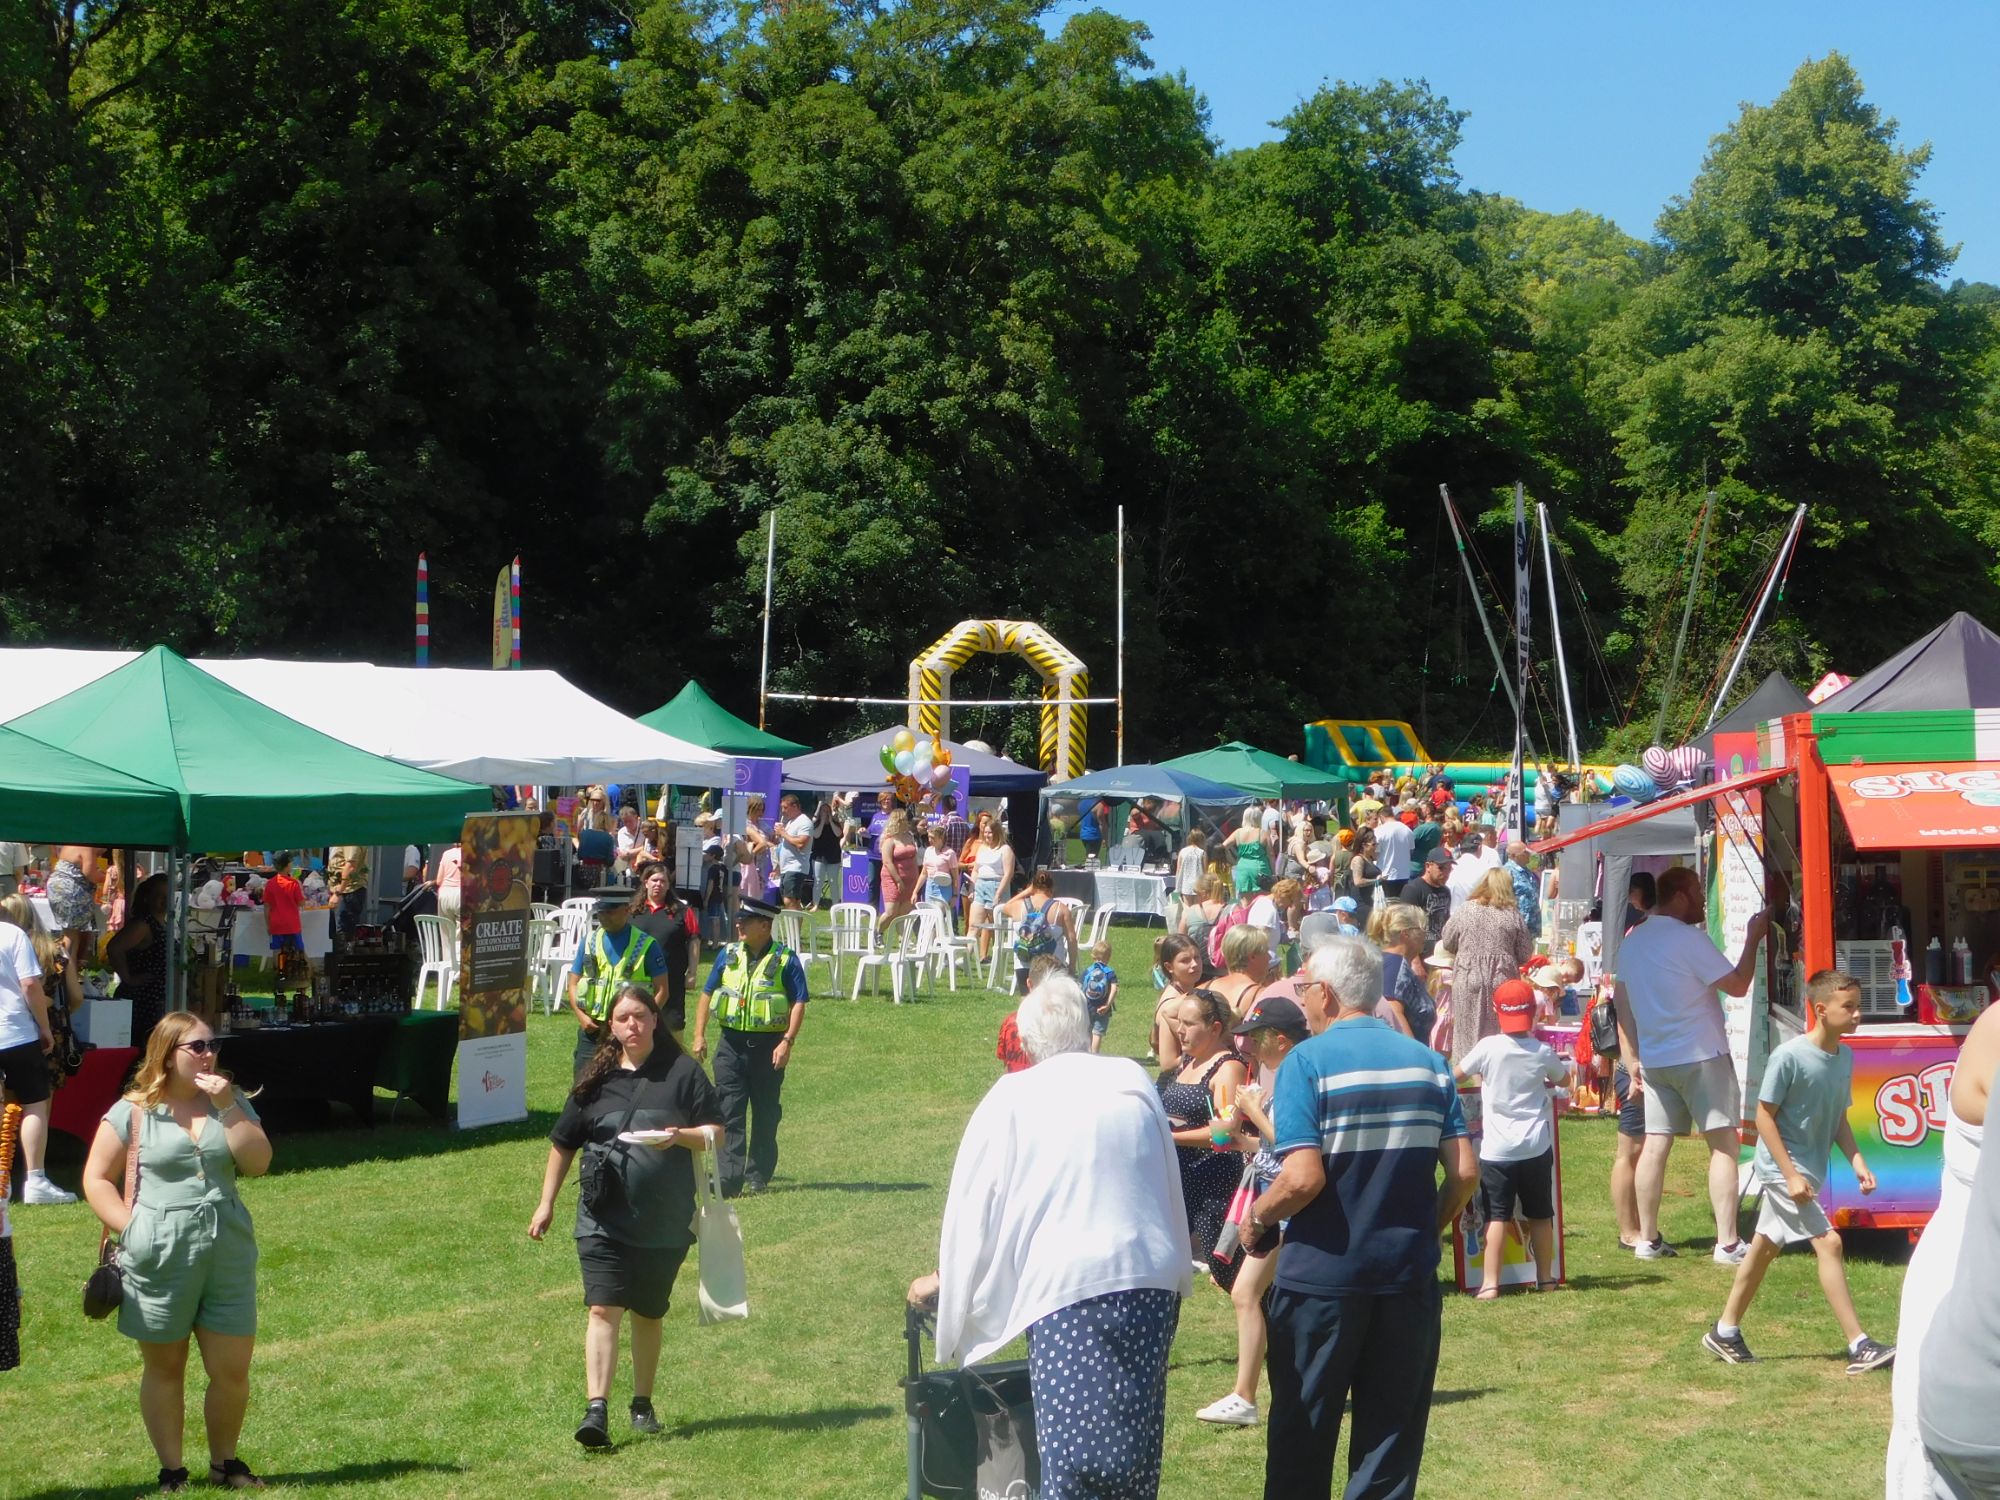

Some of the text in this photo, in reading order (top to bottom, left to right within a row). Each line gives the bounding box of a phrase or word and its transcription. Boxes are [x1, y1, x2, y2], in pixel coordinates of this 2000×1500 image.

[1508, 585, 1528, 829] BRNIES
[475, 920, 523, 938] CREATE
[487, 943, 521, 952] MASTERPIECE
